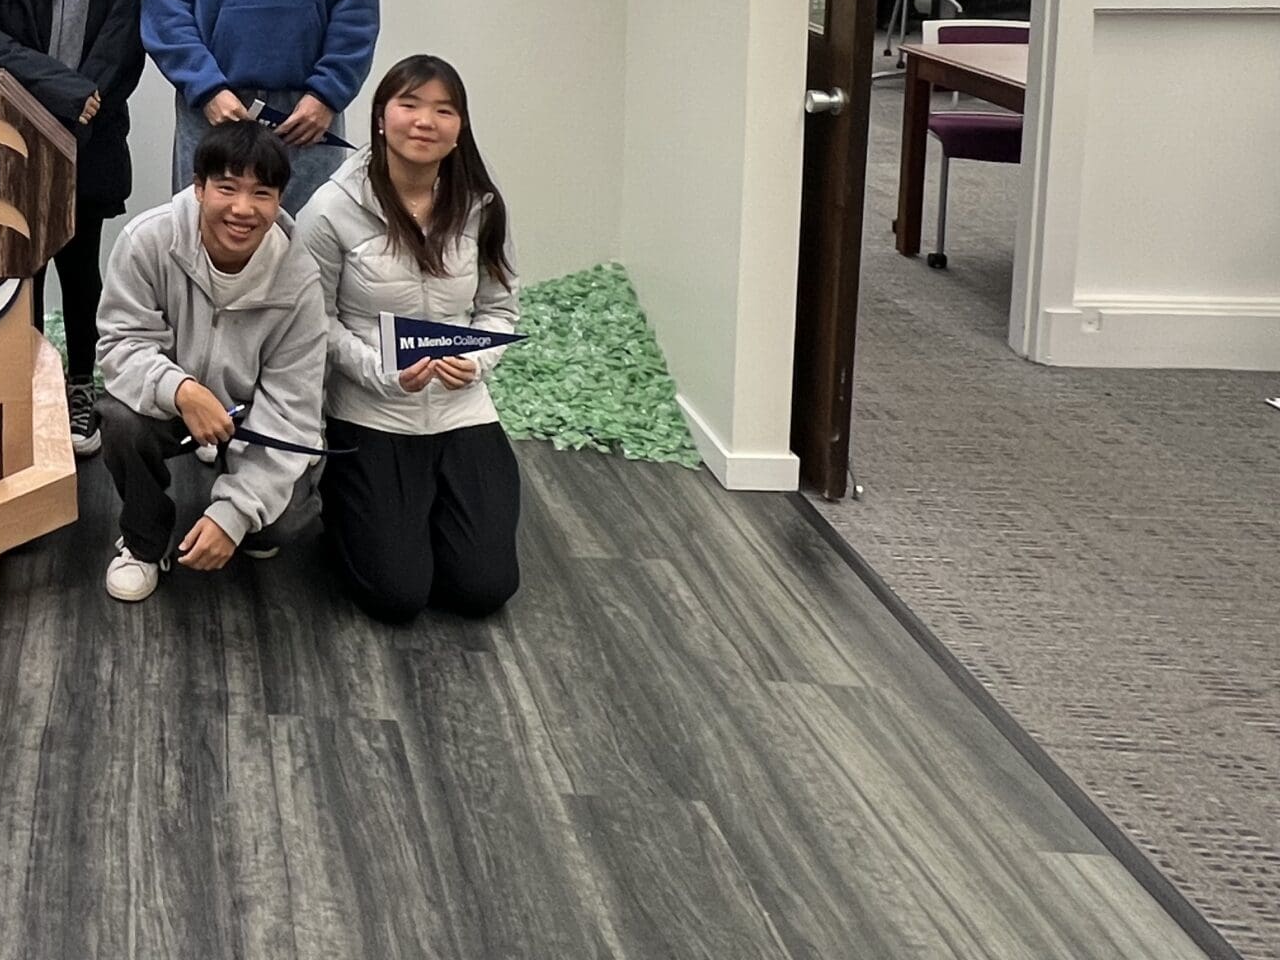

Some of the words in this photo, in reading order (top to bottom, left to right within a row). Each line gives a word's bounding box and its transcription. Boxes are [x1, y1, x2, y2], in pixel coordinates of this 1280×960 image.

[400, 337, 415, 350] M
[417, 336, 452, 348] Menlo
[453, 335, 492, 346] College
